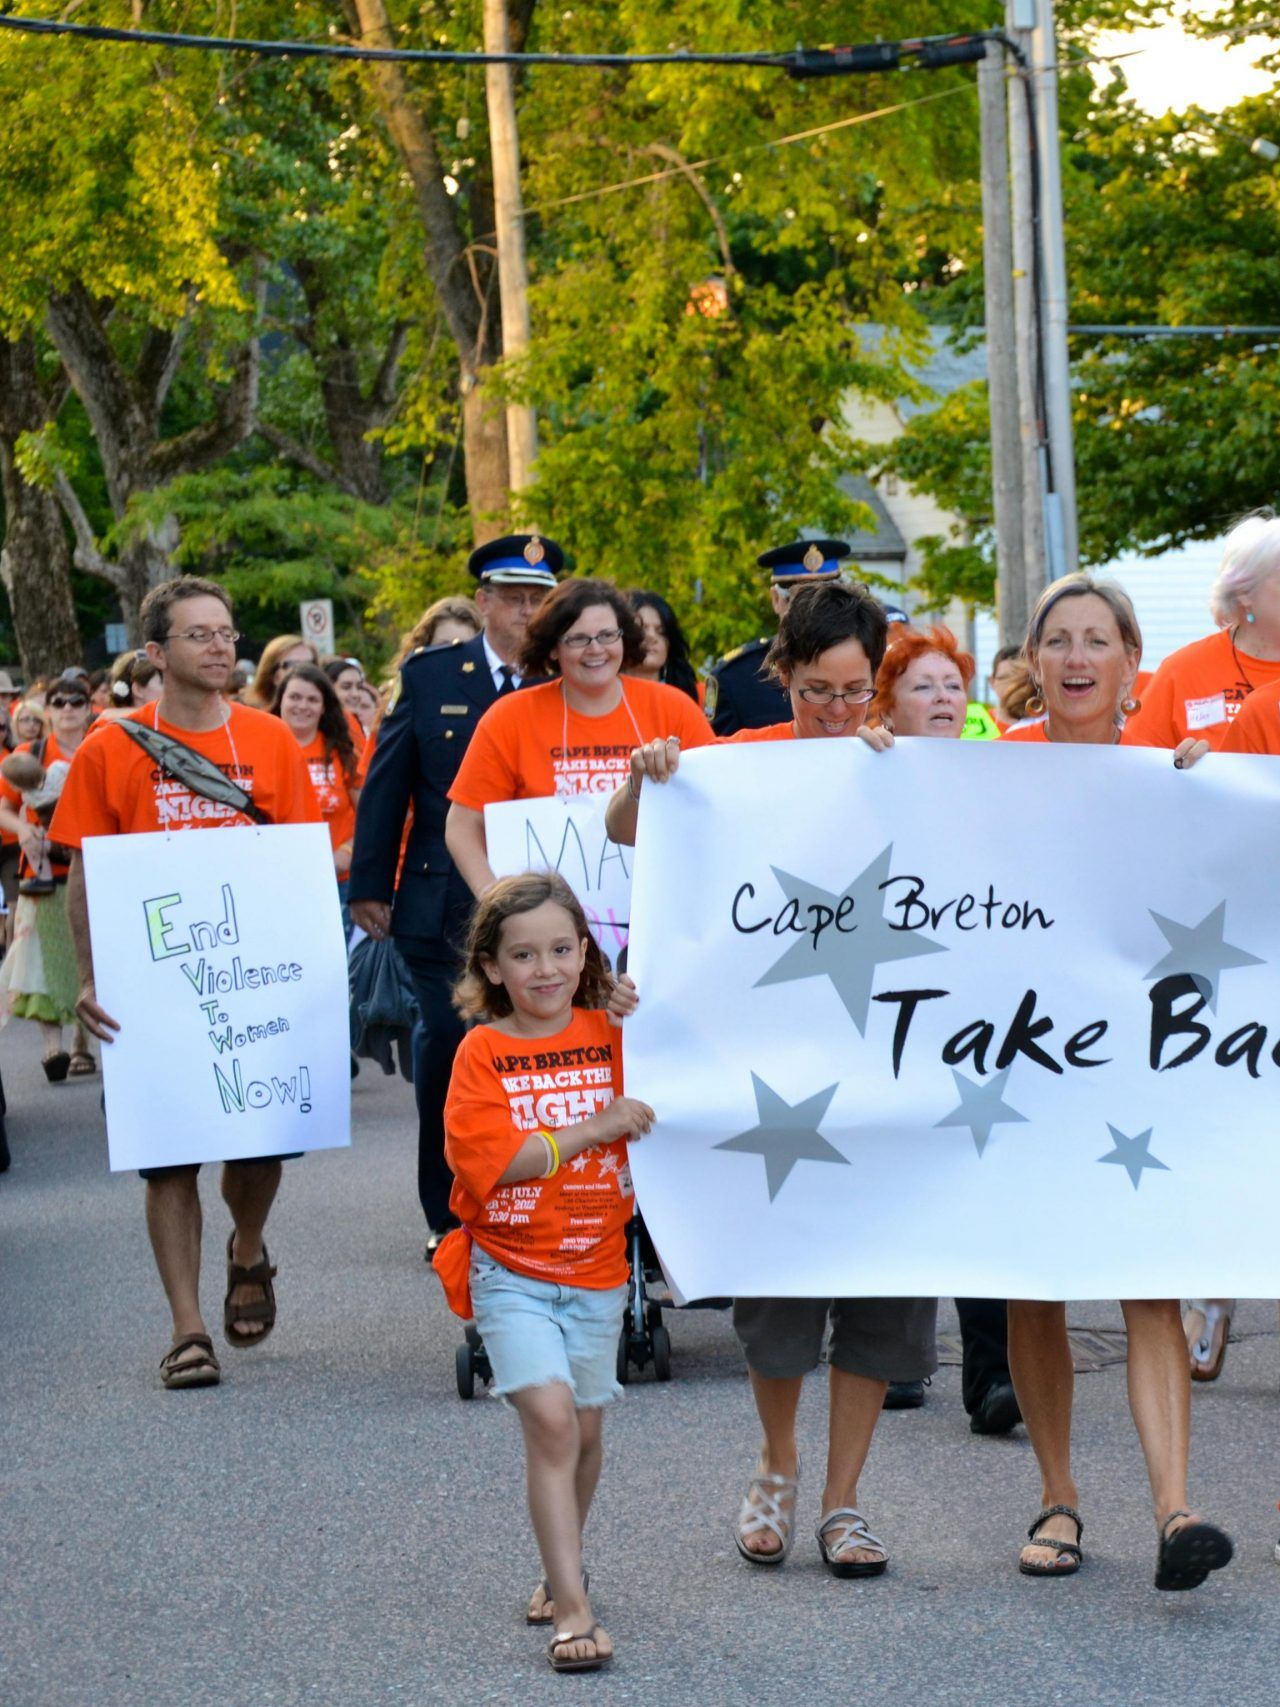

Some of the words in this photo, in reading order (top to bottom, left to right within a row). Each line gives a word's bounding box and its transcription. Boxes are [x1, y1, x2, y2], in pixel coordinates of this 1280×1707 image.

[550, 747, 590, 758] CAPE
[553, 758, 588, 772] TAKE
[589, 758, 625, 770] BACK
[143, 884, 240, 962] End
[732, 882, 858, 951] Cape
[878, 876, 1054, 932] Breton
[180, 956, 303, 996] Violence
[200, 1000, 229, 1026] To
[208, 1017, 290, 1054] Women
[871, 988, 1113, 1080] Take
[533, 1044, 613, 1070] BRETON
[213, 1058, 312, 1114] Now!
[533, 1072, 583, 1090] BACK
[582, 1066, 612, 1084] THE
[511, 1186, 543, 1200] JULY
[510, 1213, 530, 1226] pm
